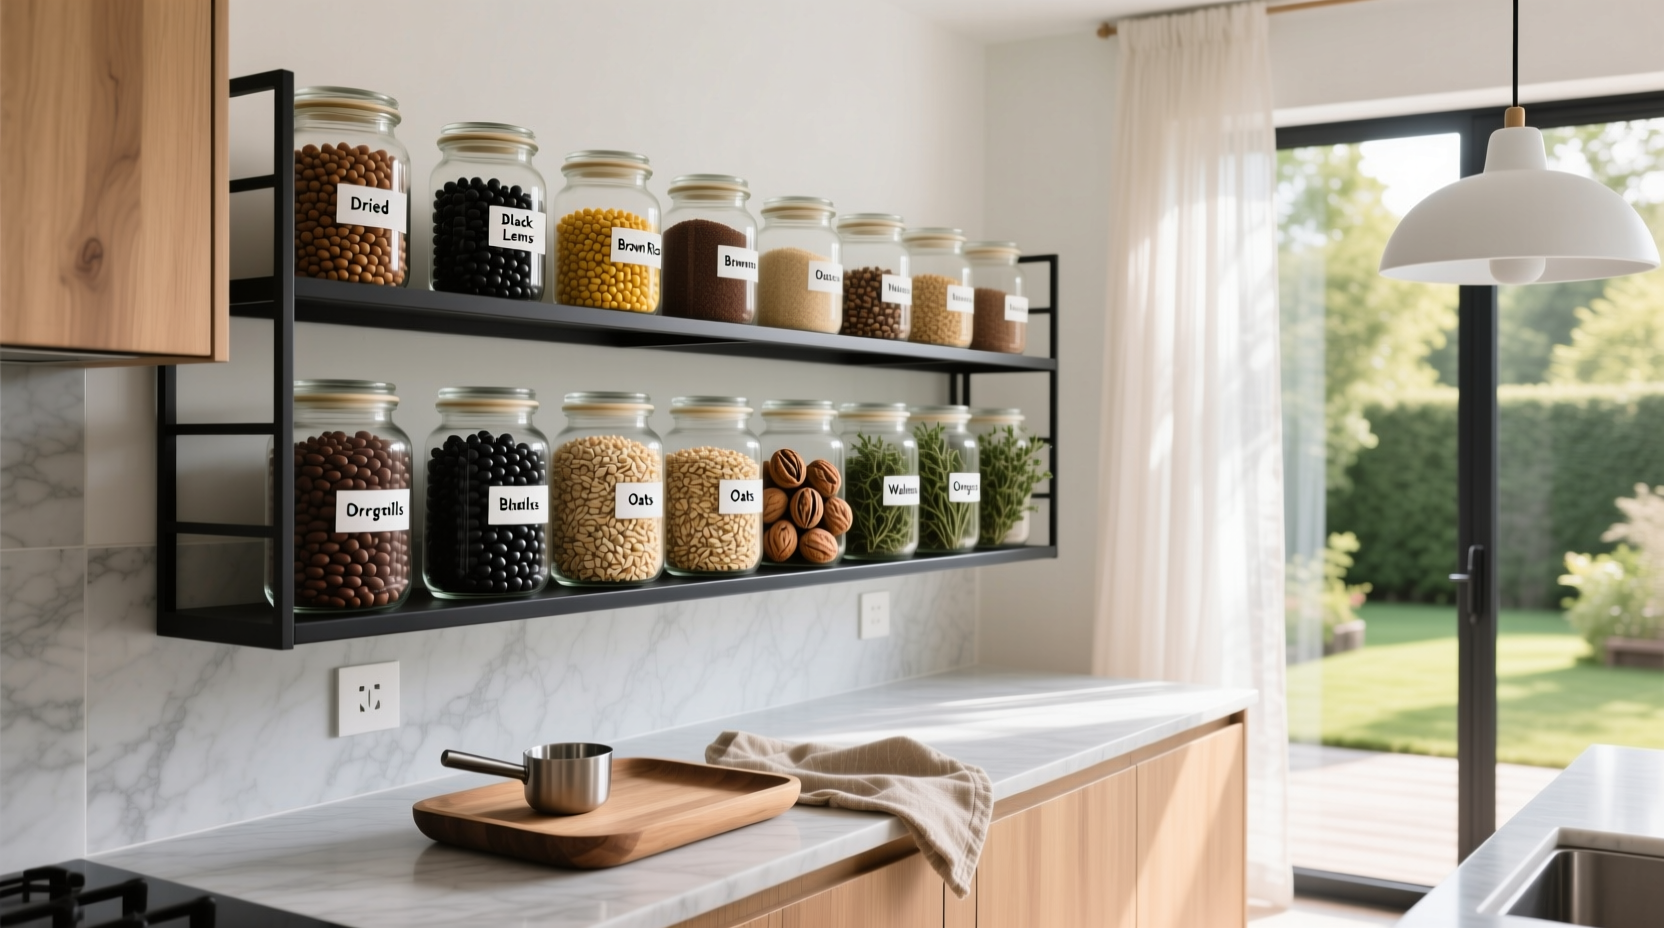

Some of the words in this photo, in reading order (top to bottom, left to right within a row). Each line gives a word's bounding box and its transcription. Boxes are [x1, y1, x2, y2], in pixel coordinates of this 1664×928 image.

[351, 196, 389, 215] Dried
[628, 493, 653, 506] Oats
[730, 489, 754, 502] Oats
